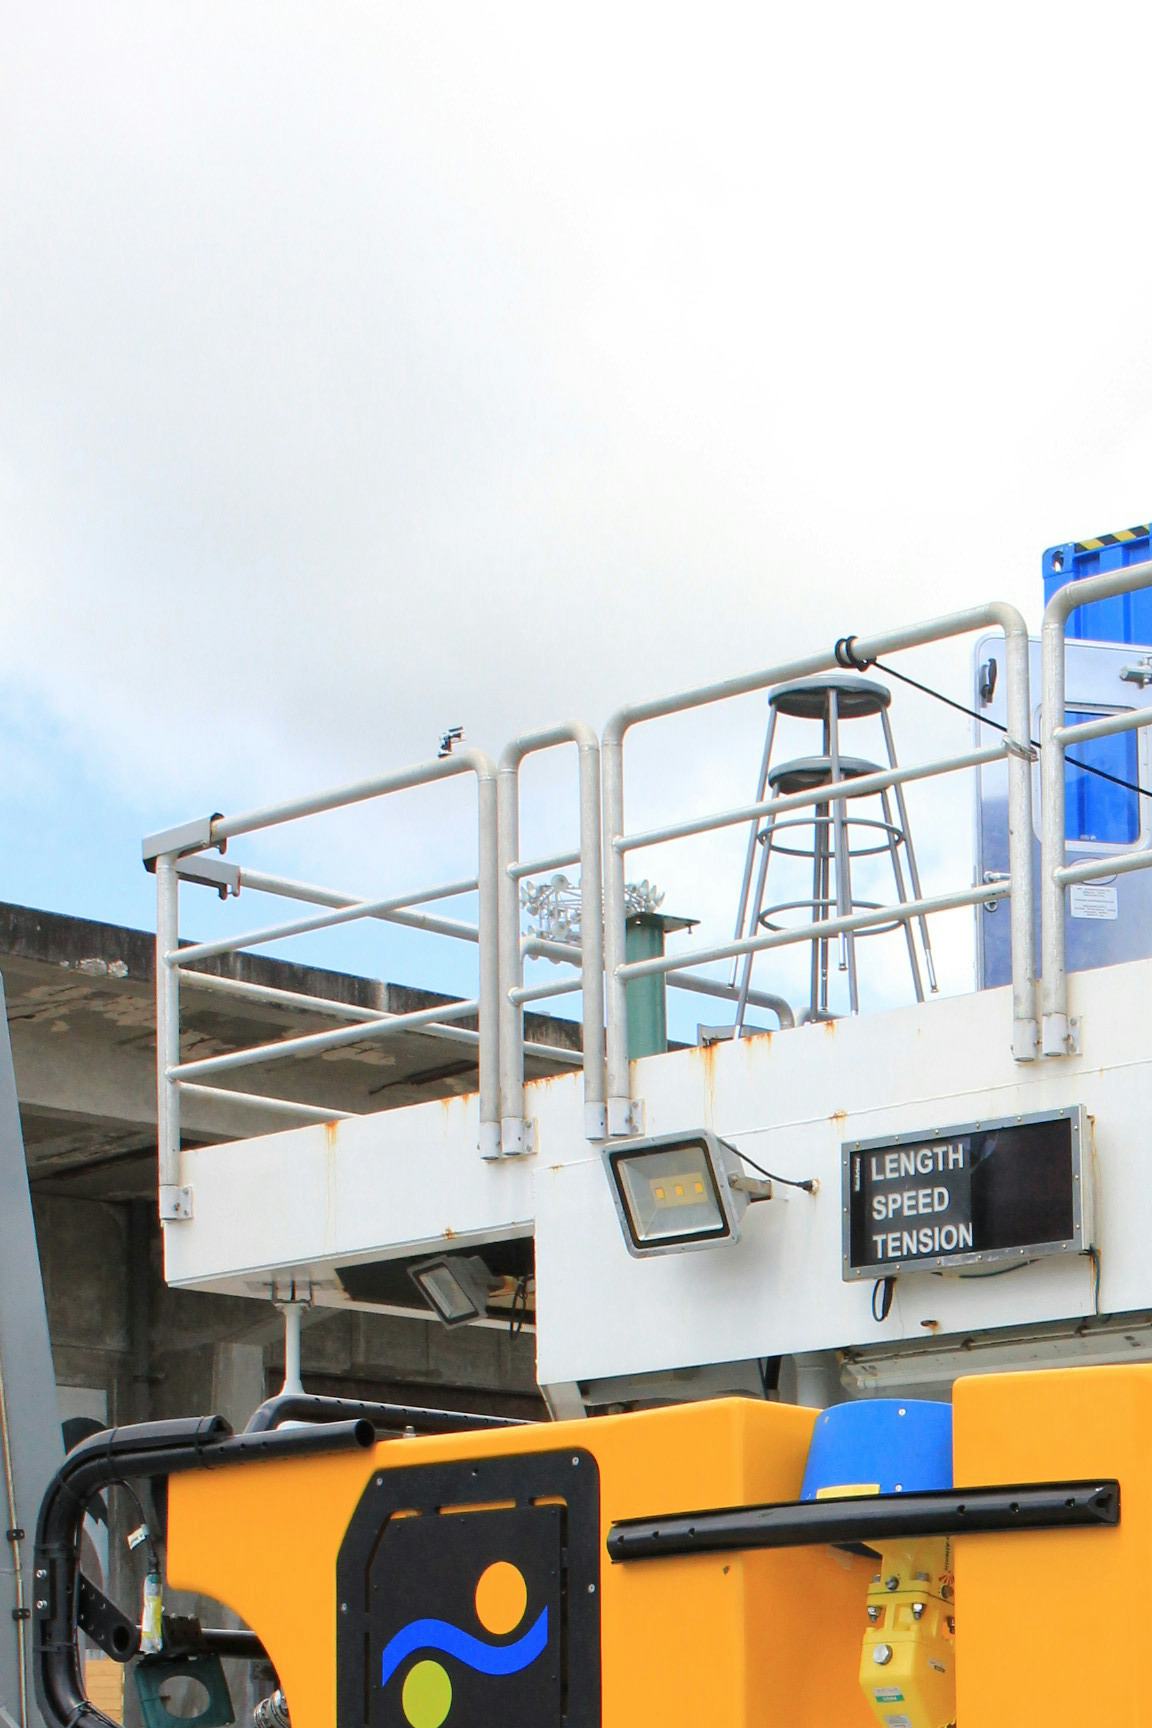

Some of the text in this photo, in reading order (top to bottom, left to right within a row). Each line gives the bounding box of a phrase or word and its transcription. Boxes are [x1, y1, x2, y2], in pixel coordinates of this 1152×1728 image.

[870, 1143, 965, 1182] LENGTH
[871, 1186, 950, 1221] SPEED
[871, 1221, 974, 1259] TENSION
